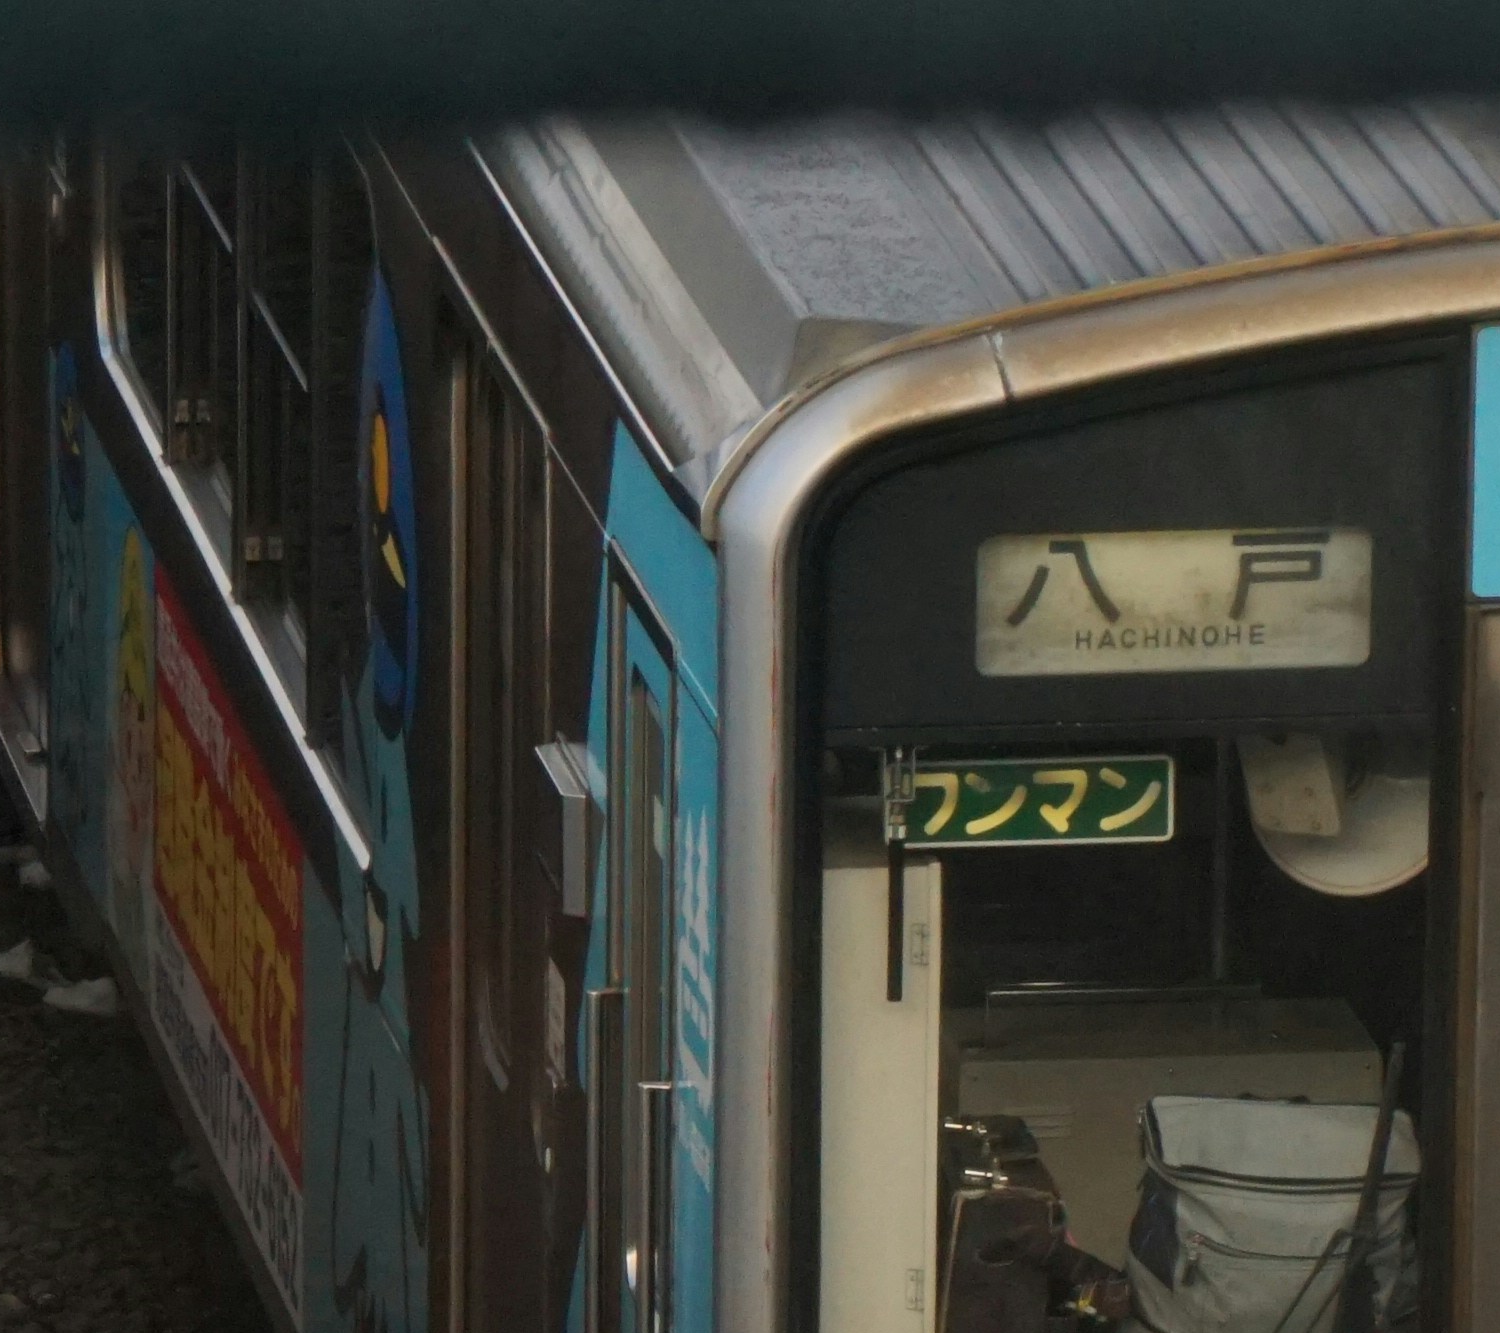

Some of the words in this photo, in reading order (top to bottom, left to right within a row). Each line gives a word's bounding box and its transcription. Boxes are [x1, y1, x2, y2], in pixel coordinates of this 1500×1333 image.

[1008, 533, 1331, 625] 八戸
[1074, 624, 1267, 650] HACHINOHE
[904, 768, 1162, 834] ワンマン
